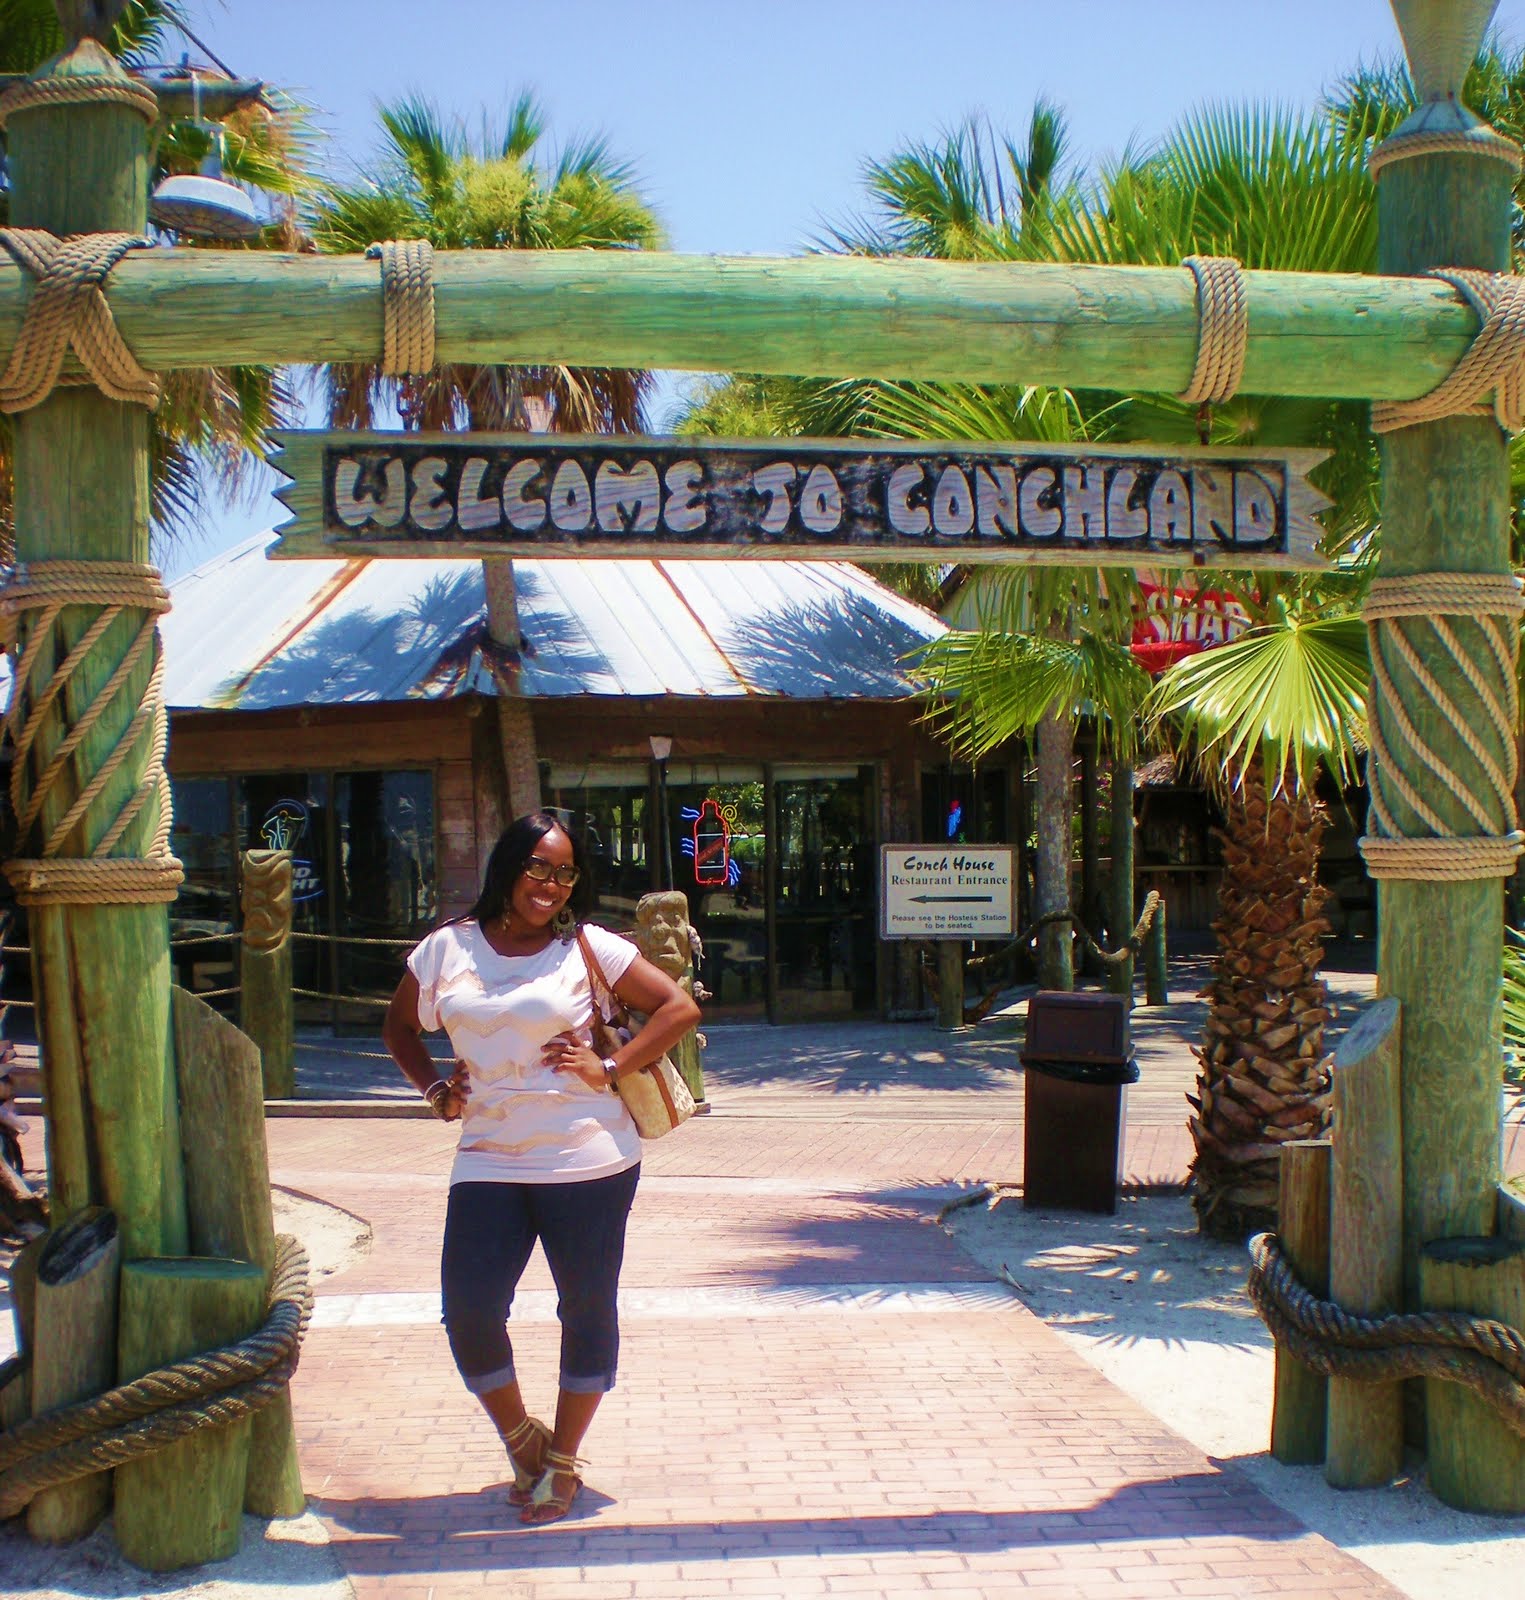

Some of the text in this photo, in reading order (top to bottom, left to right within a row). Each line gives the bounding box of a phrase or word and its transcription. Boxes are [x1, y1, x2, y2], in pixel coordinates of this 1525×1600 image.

[335, 456, 1277, 542] WELCOME TO CONCHLAND
[903, 856, 995, 871] Conch House
[891, 874, 1008, 885] Restaurant Entrance
